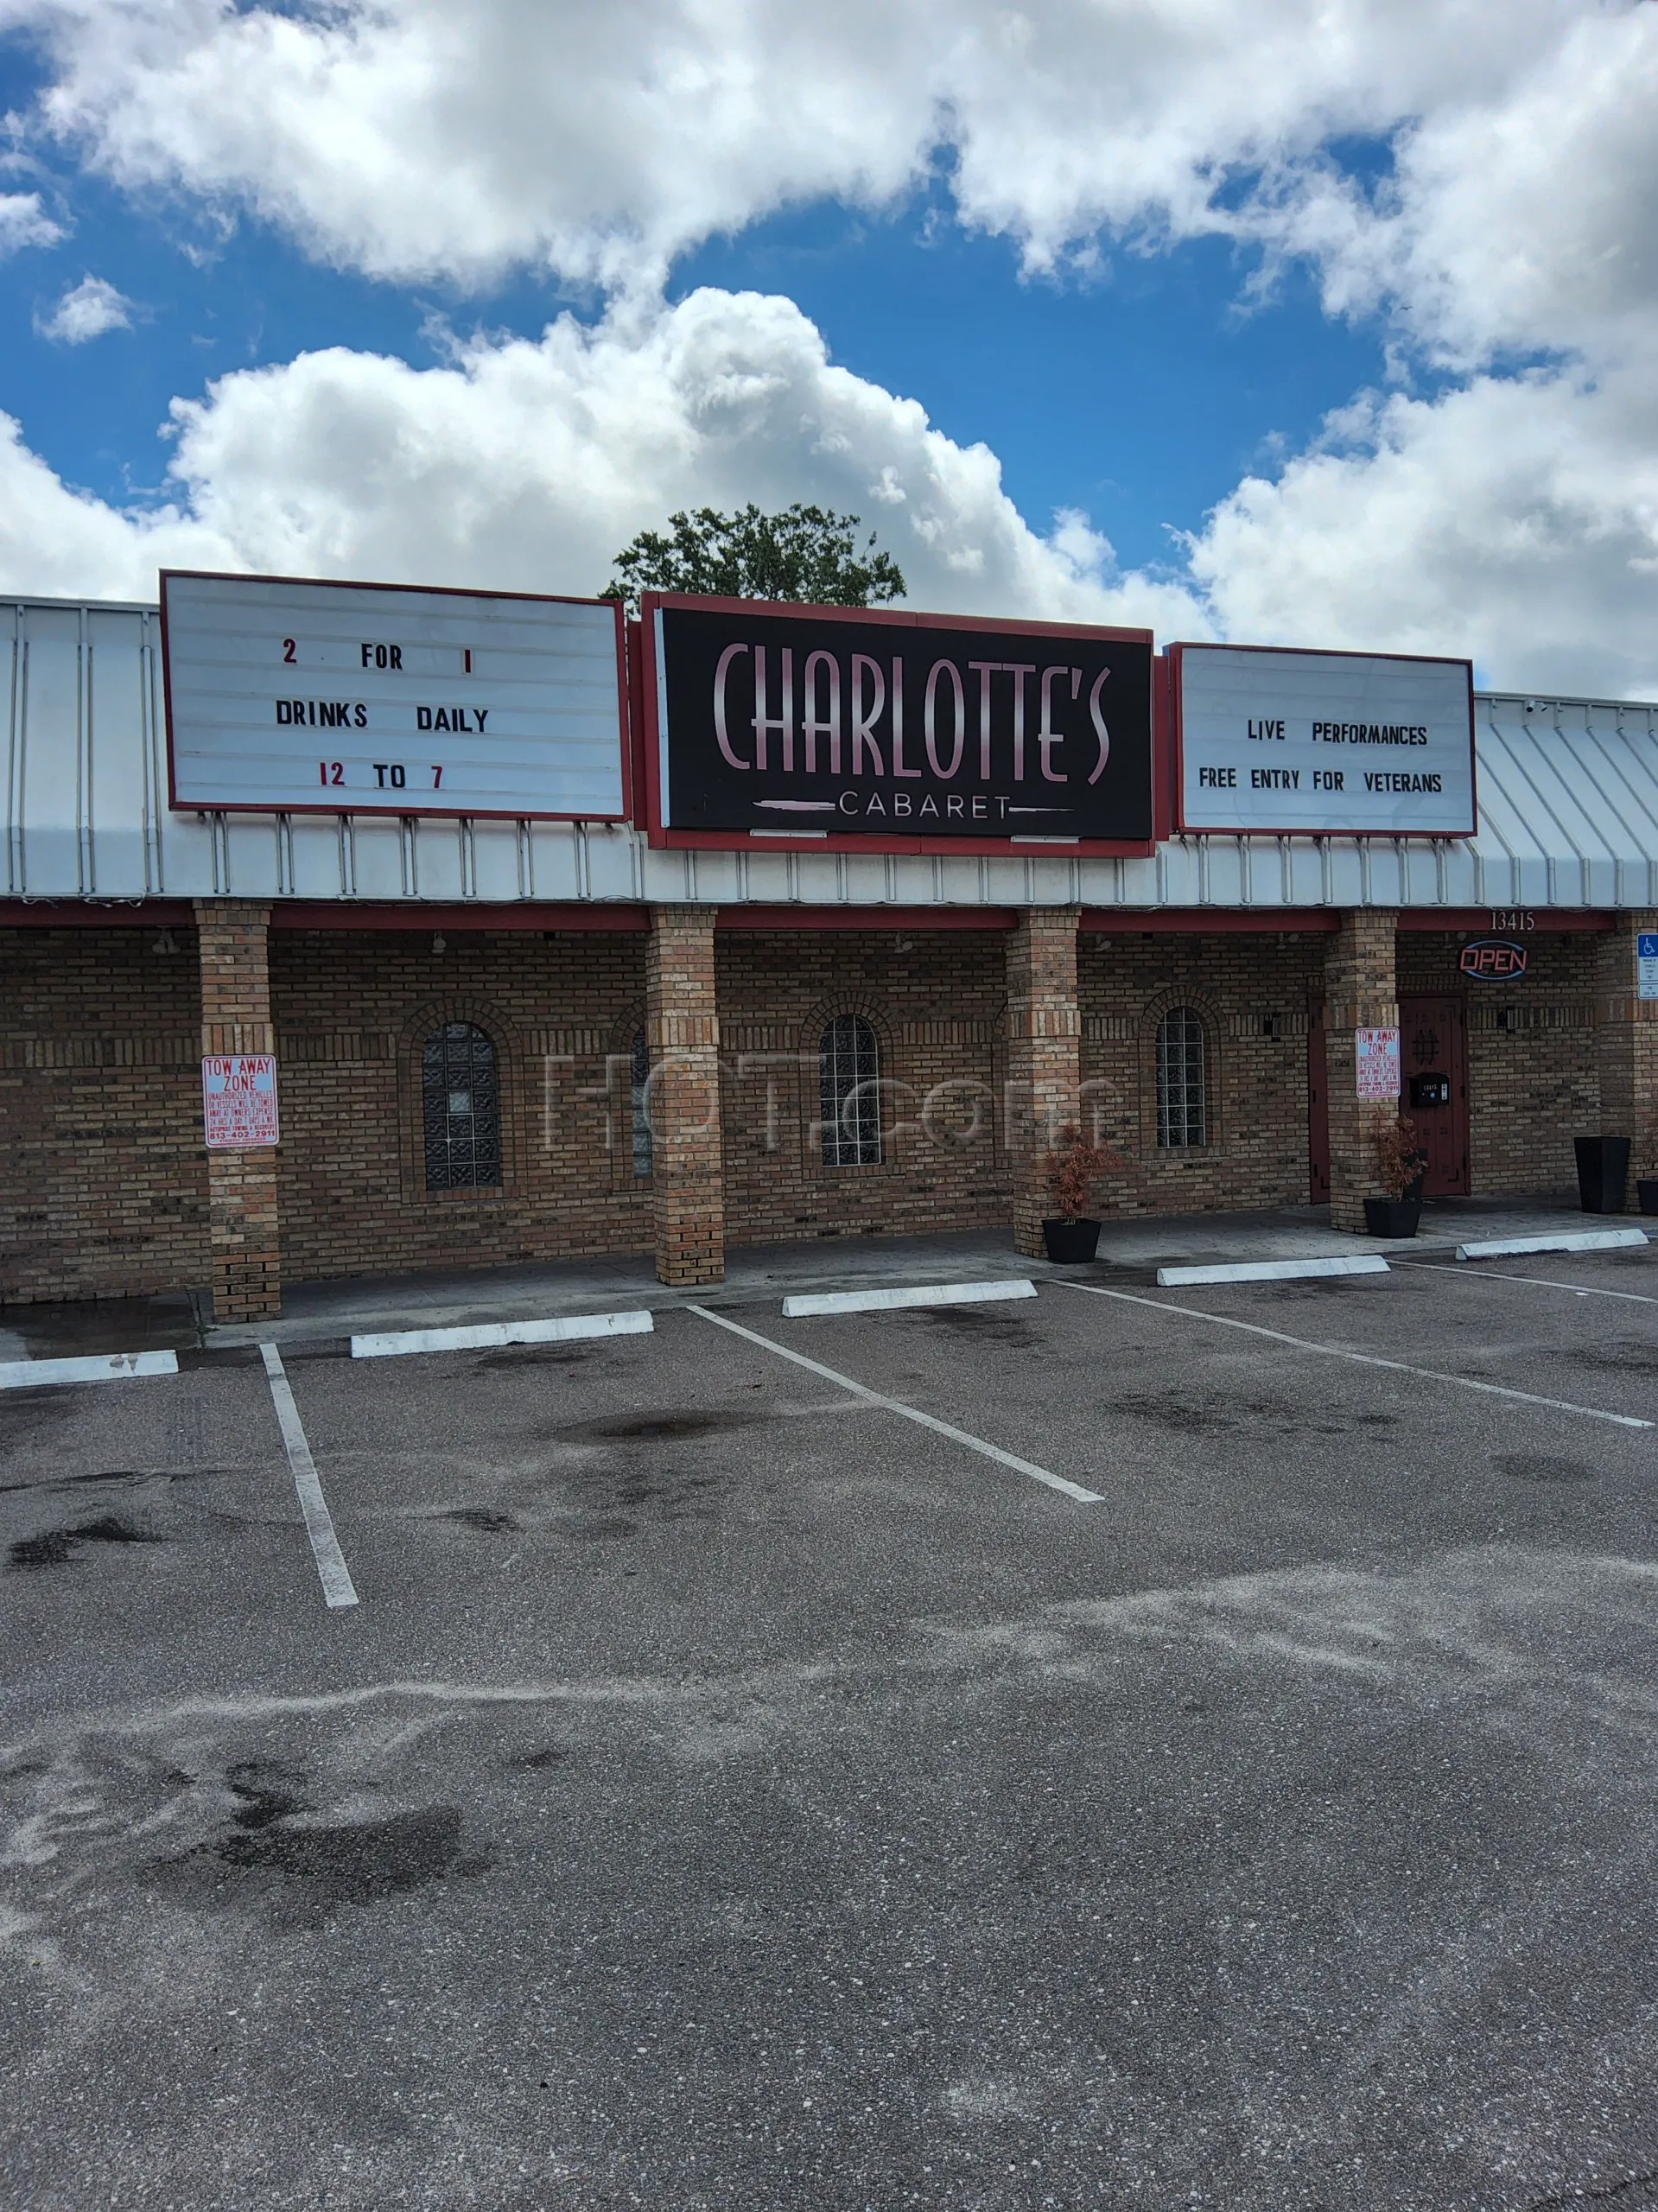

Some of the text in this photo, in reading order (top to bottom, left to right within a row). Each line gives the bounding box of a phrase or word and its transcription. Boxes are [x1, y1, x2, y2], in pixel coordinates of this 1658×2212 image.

[283, 638, 471, 673] 2 FOR 1
[276, 700, 488, 733] DRINKS DAILY
[714, 643, 1111, 785] CHARLOTTE'S
[1248, 719, 1427, 746] LIVE PERFORMANCES
[320, 761, 442, 789] 12 TO 7
[1199, 766, 1442, 793] FREE ENTRY FOR VETERANS
[839, 791, 1010, 819] CABARET
[1490, 912, 1534, 931] 13415
[1460, 949, 1528, 970] OPEN
[1358, 1030, 1396, 1043] TOW AWAY
[1368, 1043, 1388, 1055] ZONE
[207, 1058, 270, 1076] TOW AWAY
[224, 1075, 256, 1091] ZONE
[210, 1130, 275, 1139] 813-402-2911
